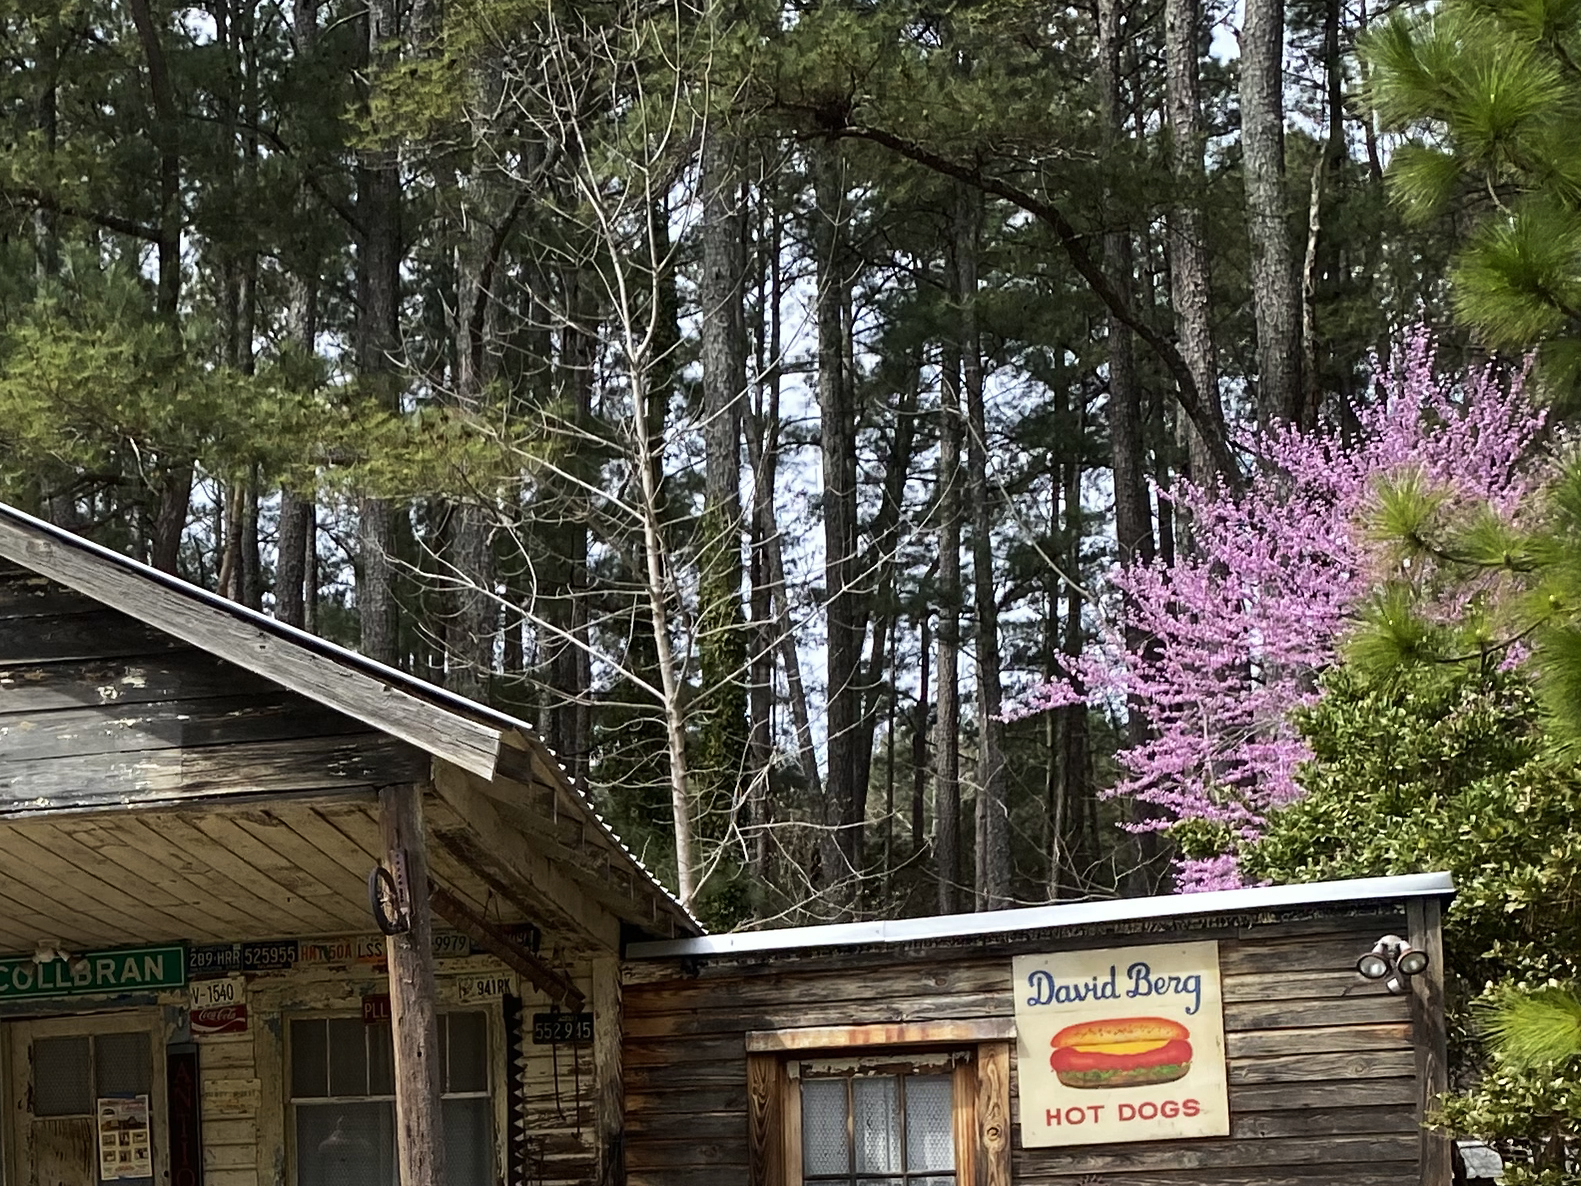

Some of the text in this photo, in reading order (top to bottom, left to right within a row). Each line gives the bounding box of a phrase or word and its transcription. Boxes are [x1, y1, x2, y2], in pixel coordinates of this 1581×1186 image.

[244, 946, 296, 965] 525955
[192, 983, 234, 1004] V-1540
[1027, 962, 1202, 1016] David Berg
[1045, 1098, 1201, 1127] HOT DOGS
